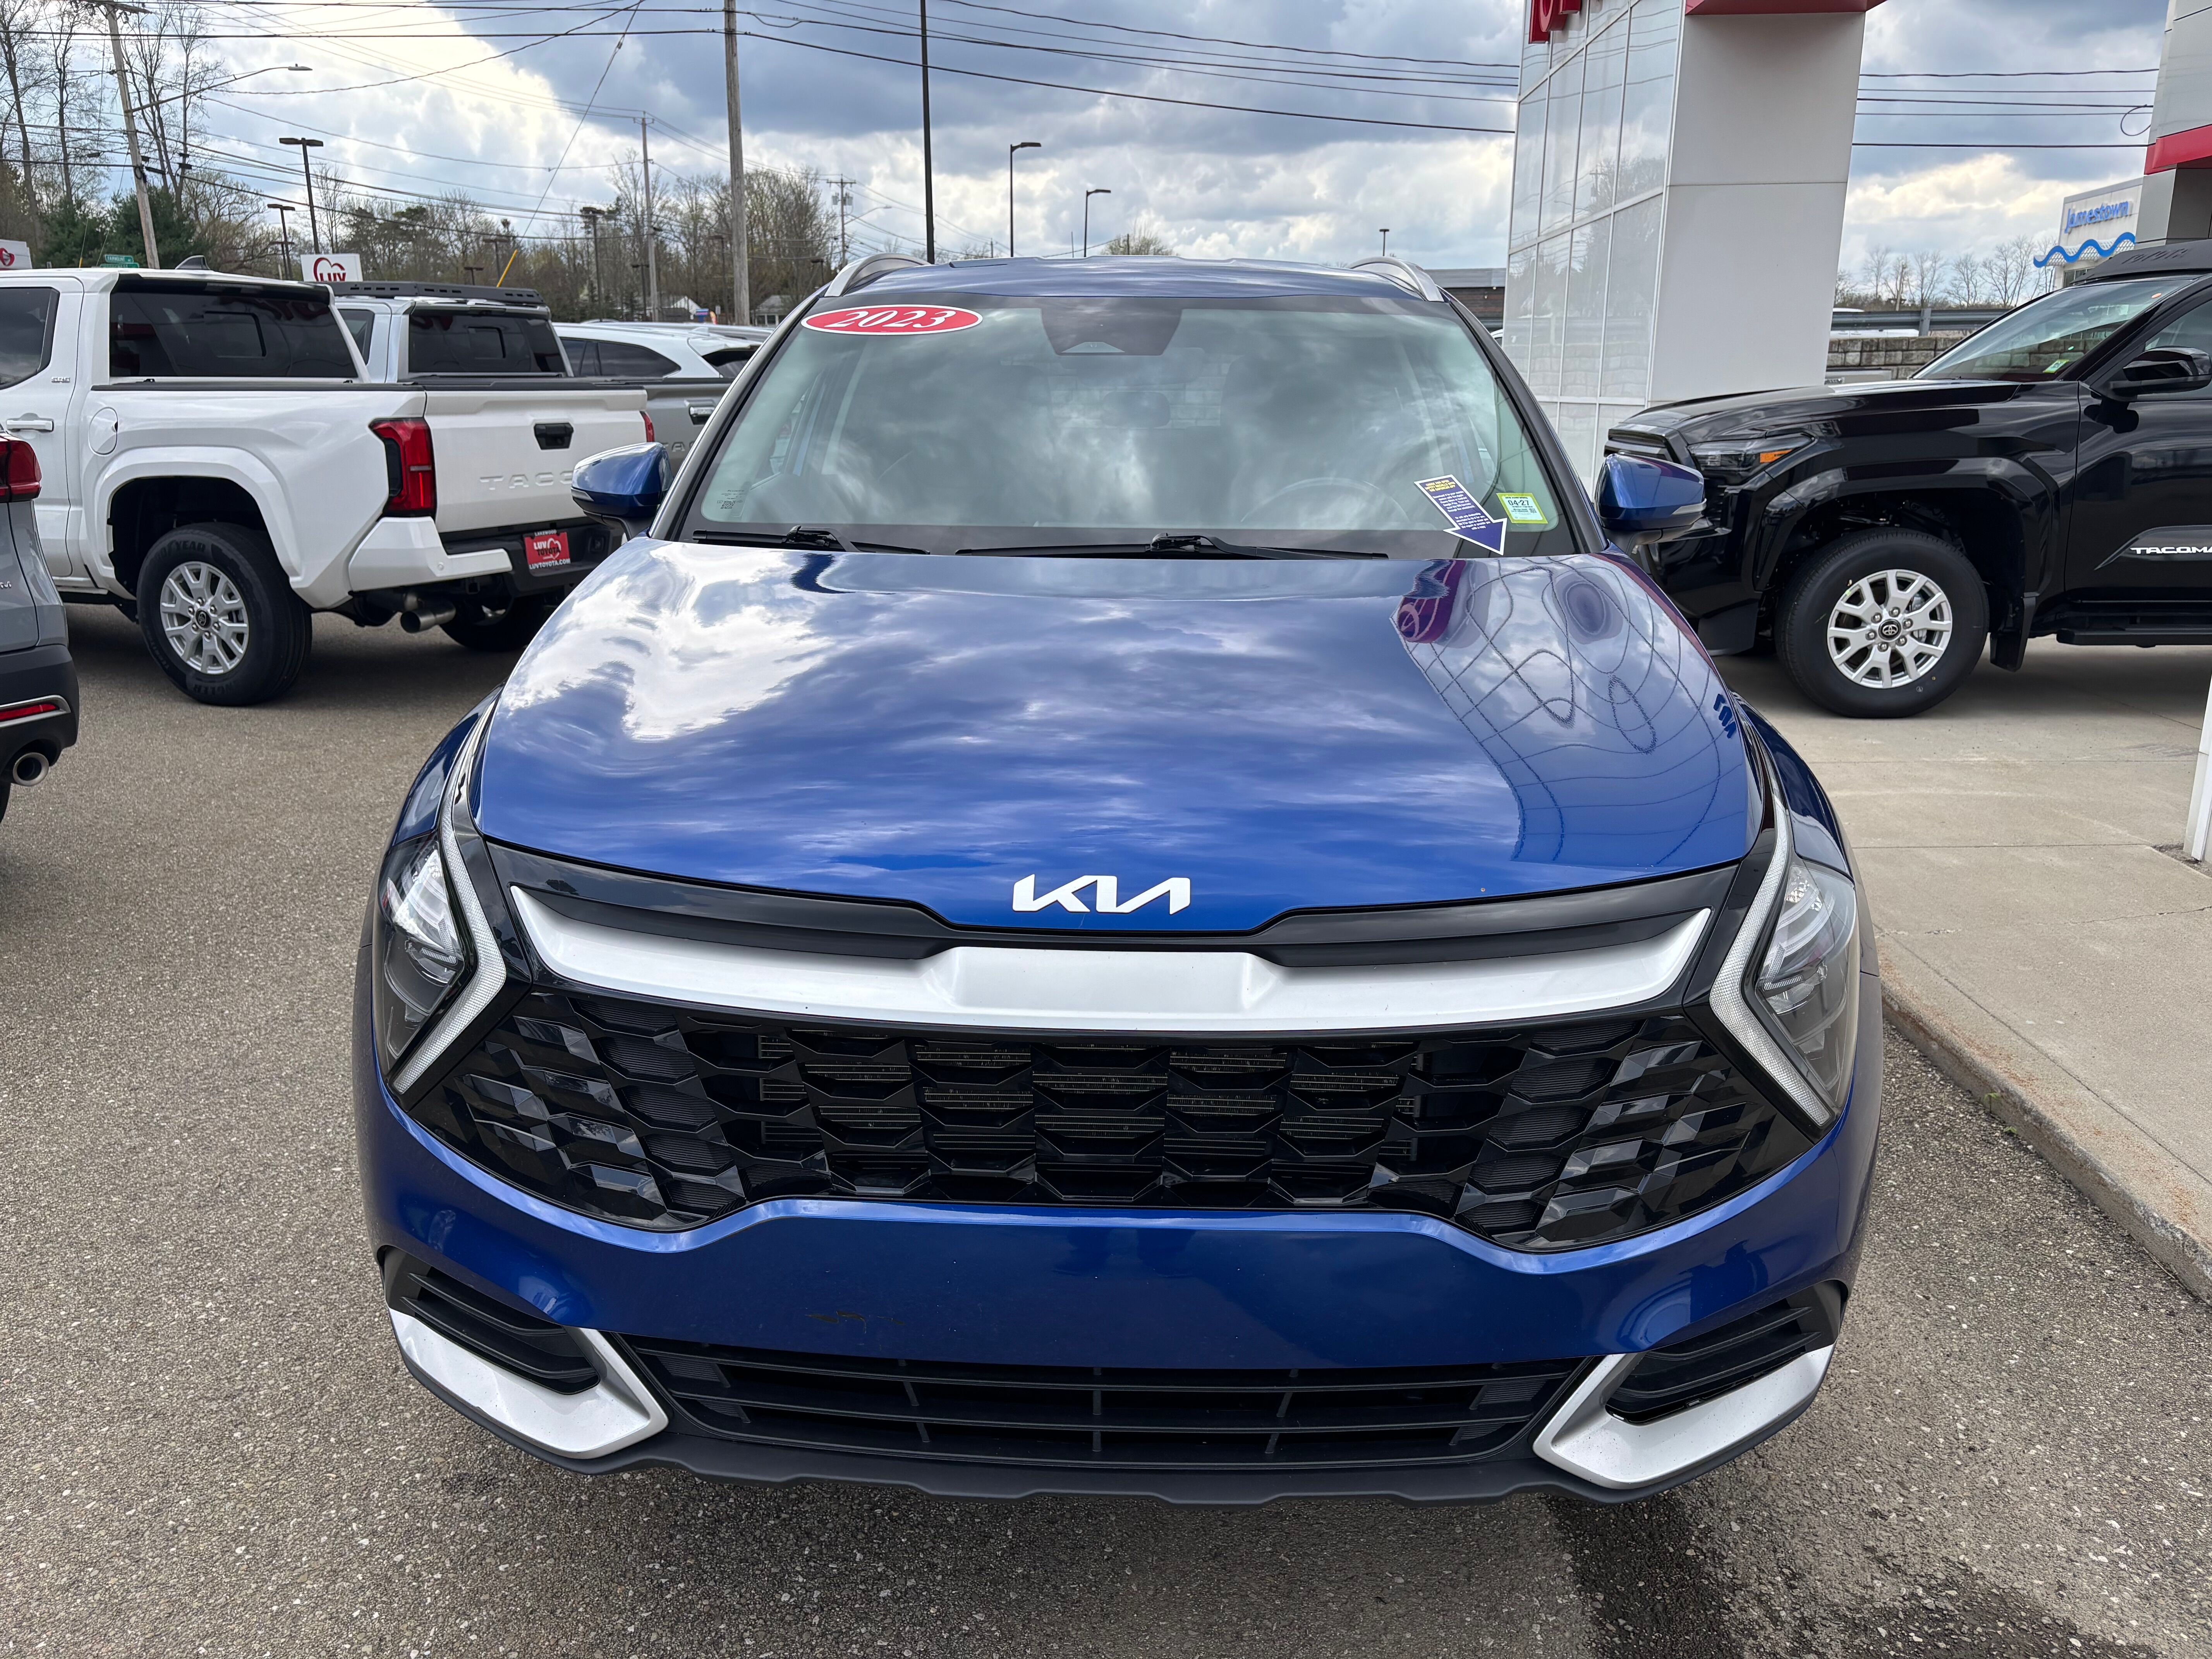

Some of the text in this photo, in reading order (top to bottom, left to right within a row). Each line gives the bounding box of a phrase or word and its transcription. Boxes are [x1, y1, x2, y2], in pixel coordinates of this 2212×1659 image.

[2064, 201, 2130, 234] Jamestown
[824, 310, 956, 328] 2023
[480, 470, 572, 490] TACO
[533, 541, 546, 550] LUV
[529, 558, 571, 570] LUVTOYOTA.COM
[1012, 874, 1190, 915] KIA
